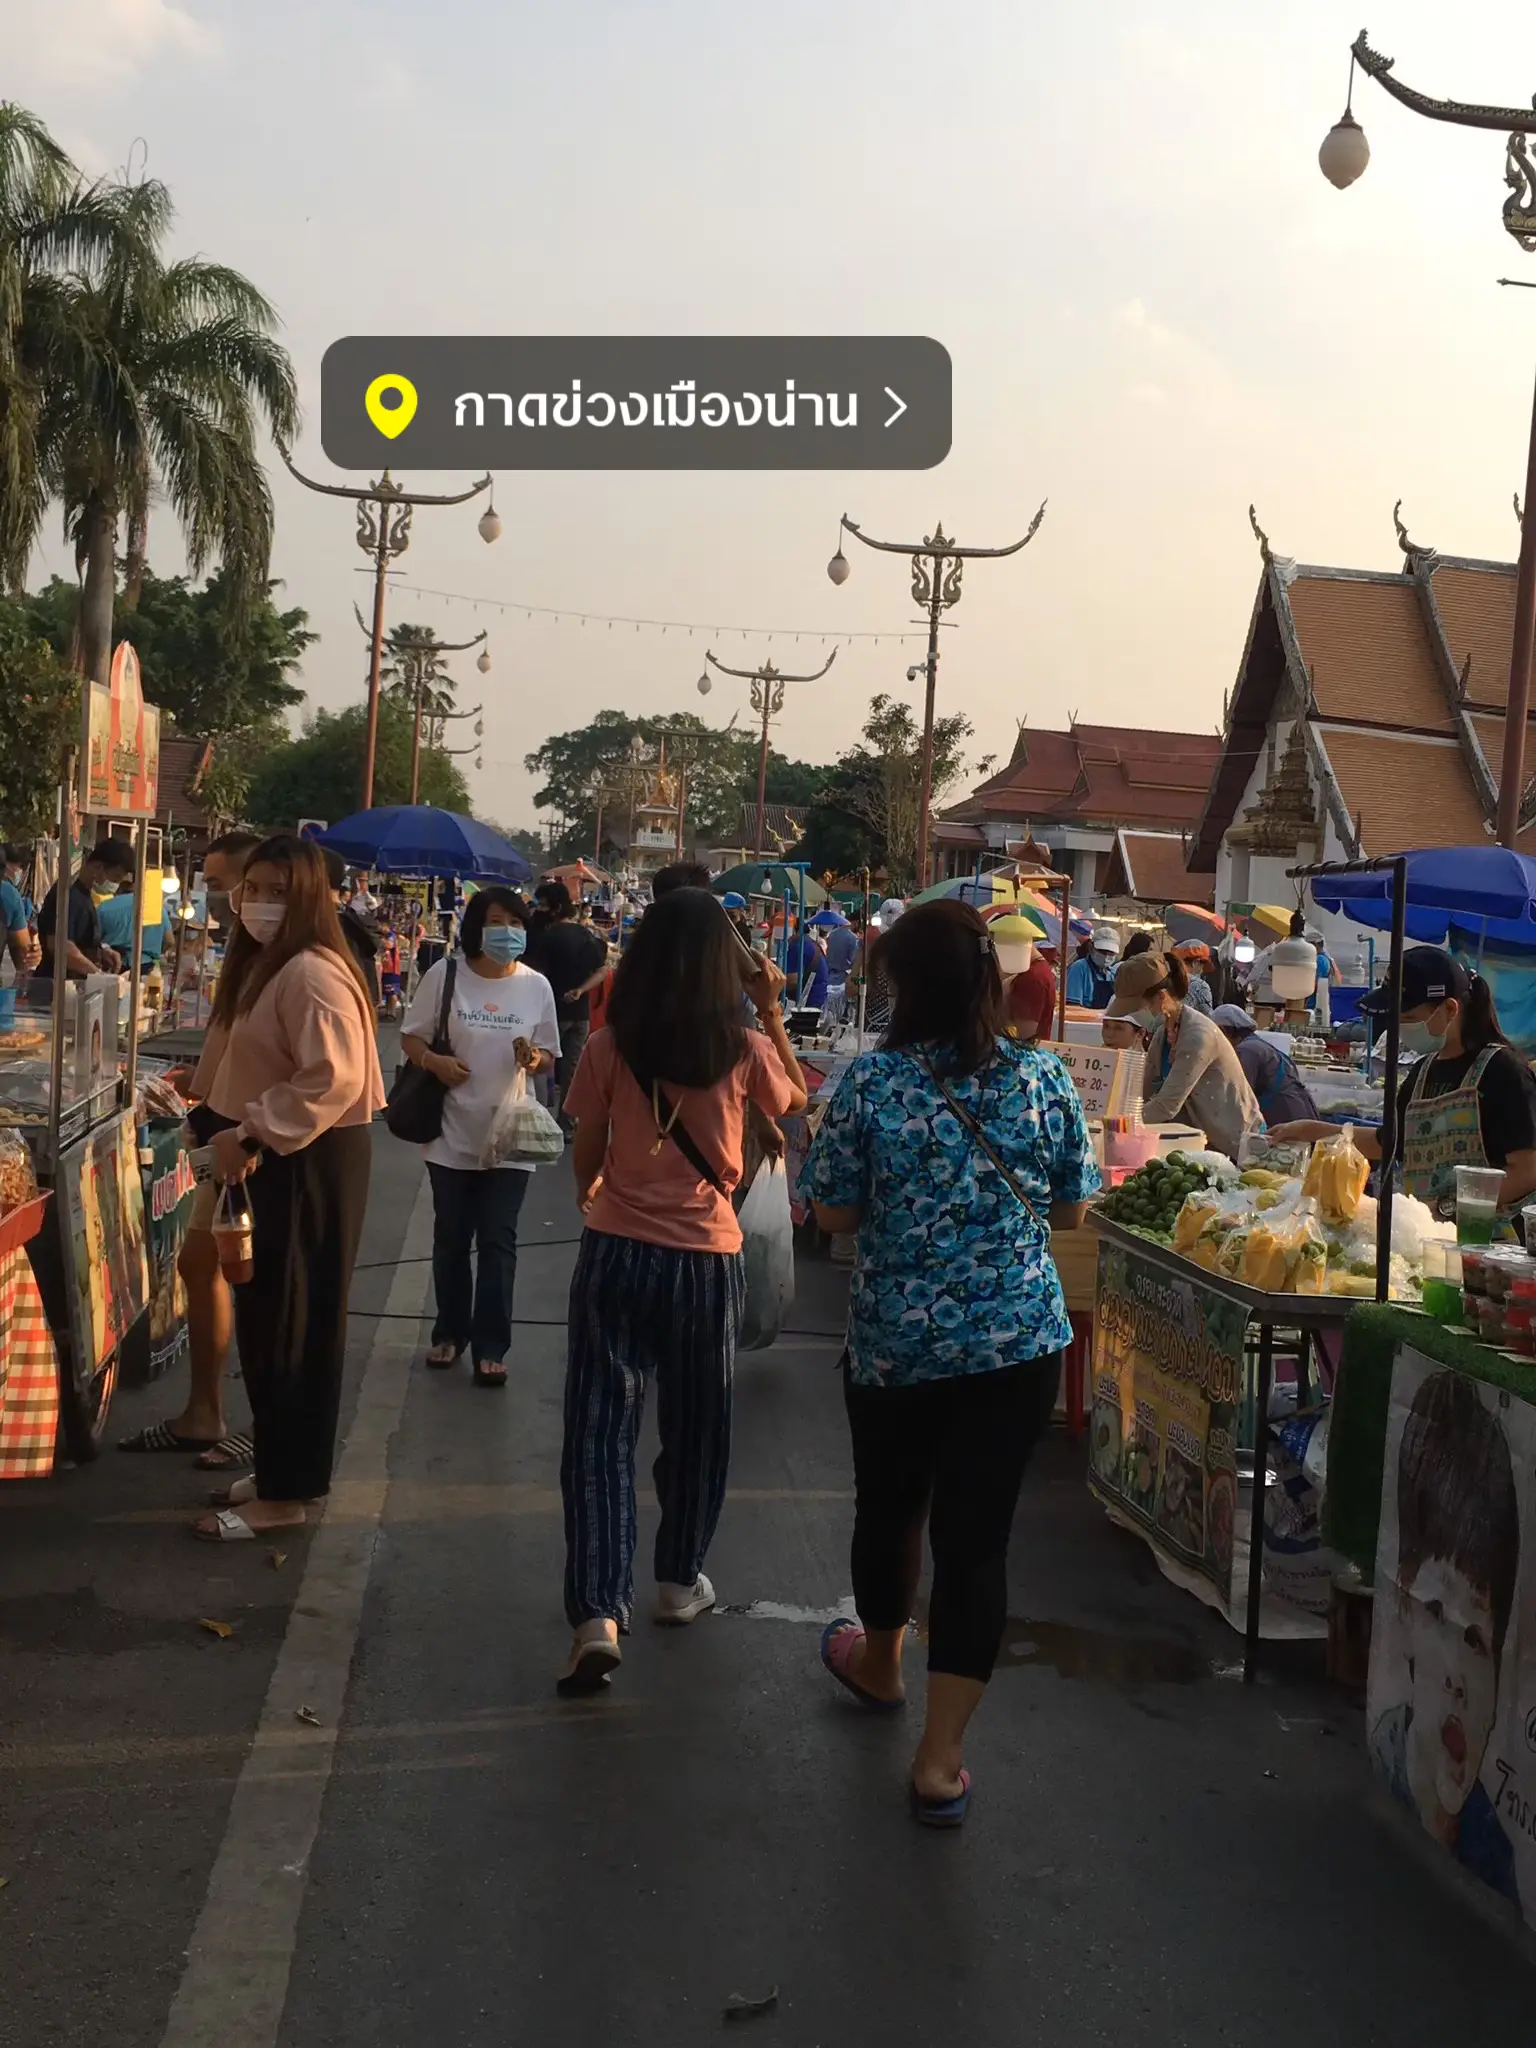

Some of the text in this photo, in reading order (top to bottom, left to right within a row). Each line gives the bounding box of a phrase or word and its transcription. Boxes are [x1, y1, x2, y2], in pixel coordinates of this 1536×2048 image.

[1084, 1058, 1111, 1071] 10.-
[1089, 1077, 1108, 1091] 20.-
[1084, 1099, 1104, 1112] 25.-
